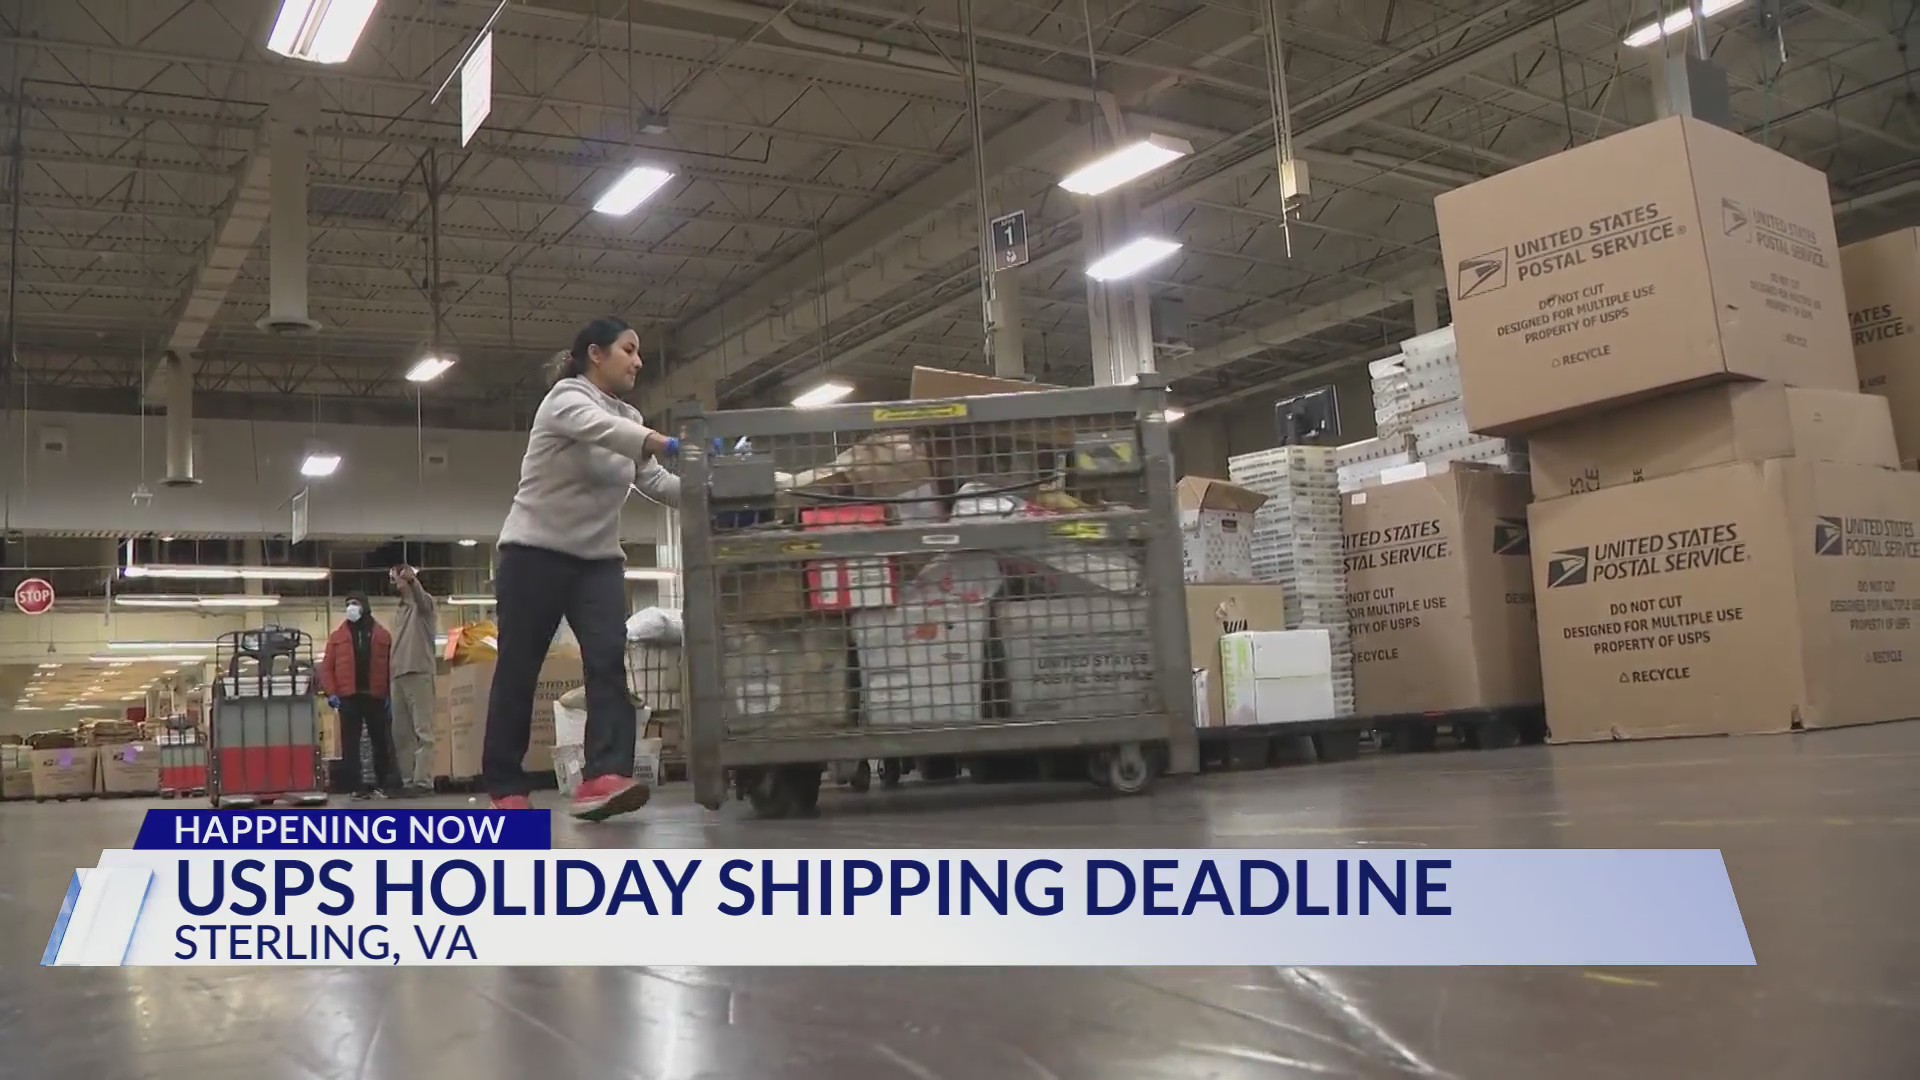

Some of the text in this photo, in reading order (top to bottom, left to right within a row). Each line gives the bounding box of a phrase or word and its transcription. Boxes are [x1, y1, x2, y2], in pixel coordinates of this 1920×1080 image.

[1004, 226, 1014, 246] 1
[1514, 203, 1659, 259] UNITED STATES
[1517, 250, 1587, 281] POSTAL
[1557, 290, 1580, 305] NOT
[1582, 283, 1605, 298] CUT
[1497, 284, 1656, 337] DESIGNED FOR MULTIPLE USE
[1848, 304, 1892, 326] TATES
[1524, 308, 1629, 344] PROPERTY OF USPS
[1855, 321, 1904, 346] RVICE
[1562, 345, 1611, 366] RECYCLE
[1342, 519, 1441, 549] ITED STATES
[1845, 516, 1915, 538] UNITED STATES
[1594, 523, 1738, 562] UNITED STATES
[1846, 538, 1883, 557] POSTAL
[1343, 542, 1448, 574] STAL SERVICE
[1593, 543, 1746, 582] POSTAL SERVICE
[19, 589, 50, 604] STOP
[1348, 587, 1395, 604] NOT CUT
[1367, 600, 1421, 616] MULTIPLE
[1423, 597, 1447, 610] USE
[1610, 595, 1683, 616] DO NOT CUT
[1372, 619, 1388, 632] OF
[1390, 616, 1421, 631] USPS
[1563, 607, 1743, 639] DESIGNED FOR MULTIPLE USE
[1594, 630, 1711, 654] PROPERTY OF USPS
[1632, 667, 1690, 683] RECYCLE
